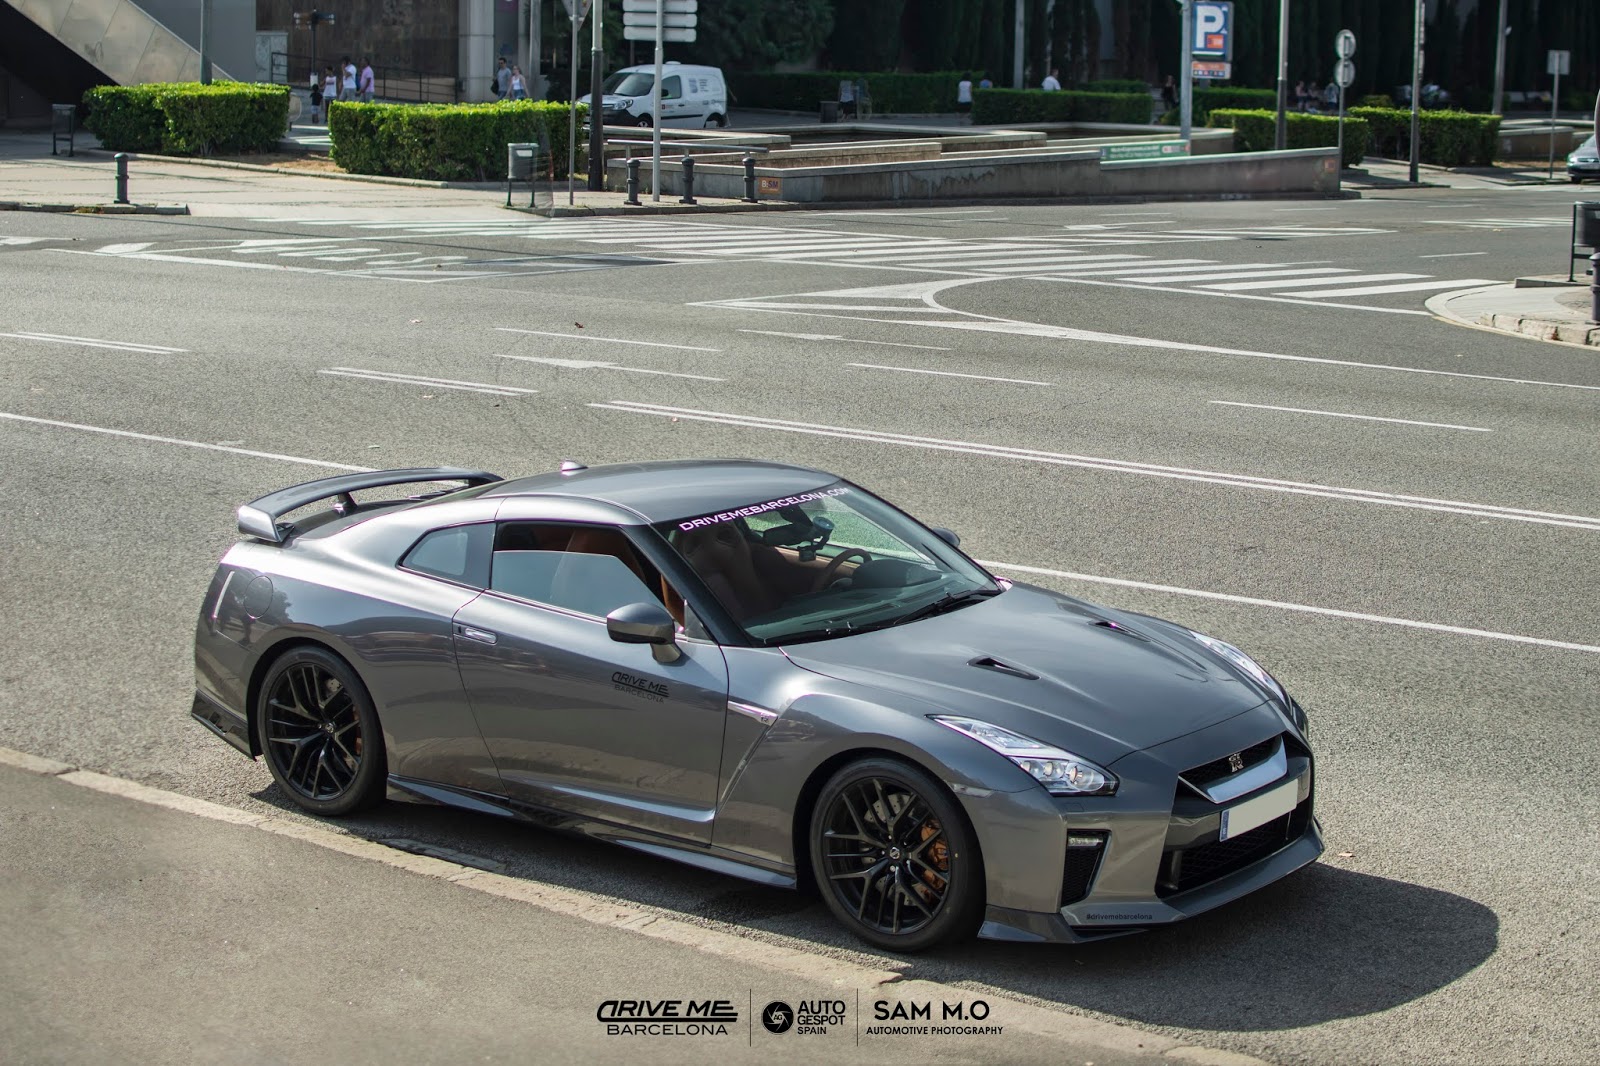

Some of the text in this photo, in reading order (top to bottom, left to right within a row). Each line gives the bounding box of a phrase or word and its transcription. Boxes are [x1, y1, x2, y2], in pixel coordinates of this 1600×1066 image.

[1196, 5, 1225, 49] P
[679, 487, 851, 532] DRIVEMEBARCELONA.COM
[612, 671, 670, 697] DRIVE ME
[614, 684, 665, 704] BARCELONA
